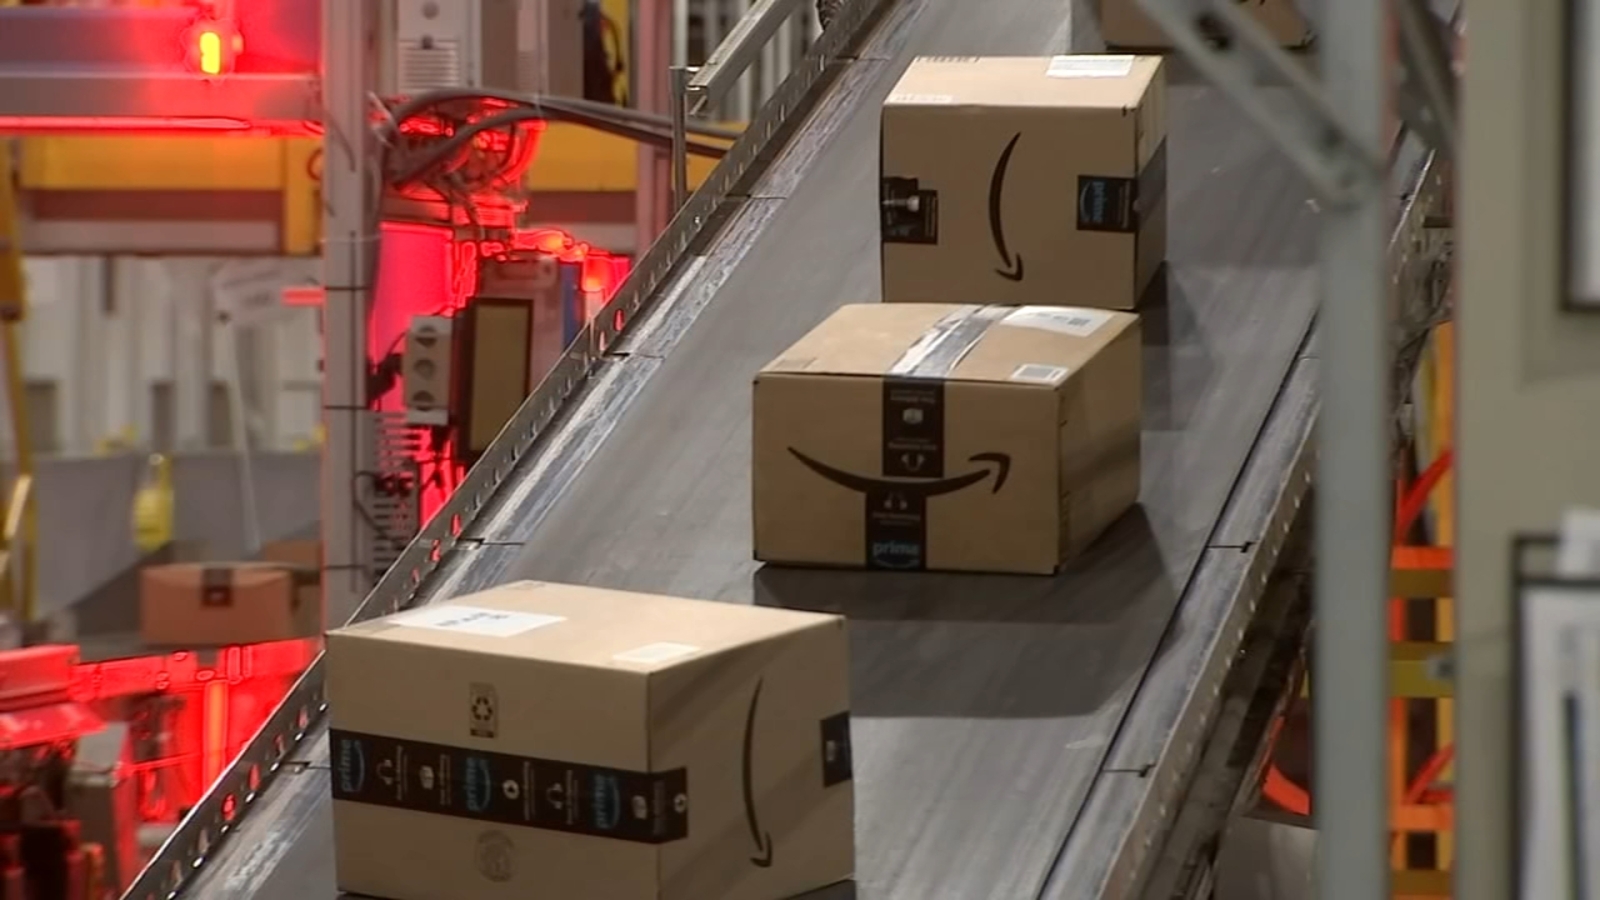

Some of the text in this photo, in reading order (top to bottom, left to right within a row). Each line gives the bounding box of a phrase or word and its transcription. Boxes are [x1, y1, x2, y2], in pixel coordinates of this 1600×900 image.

[872, 541, 919, 558] prime
[338, 739, 354, 792] prime
[462, 757, 480, 811] prime
